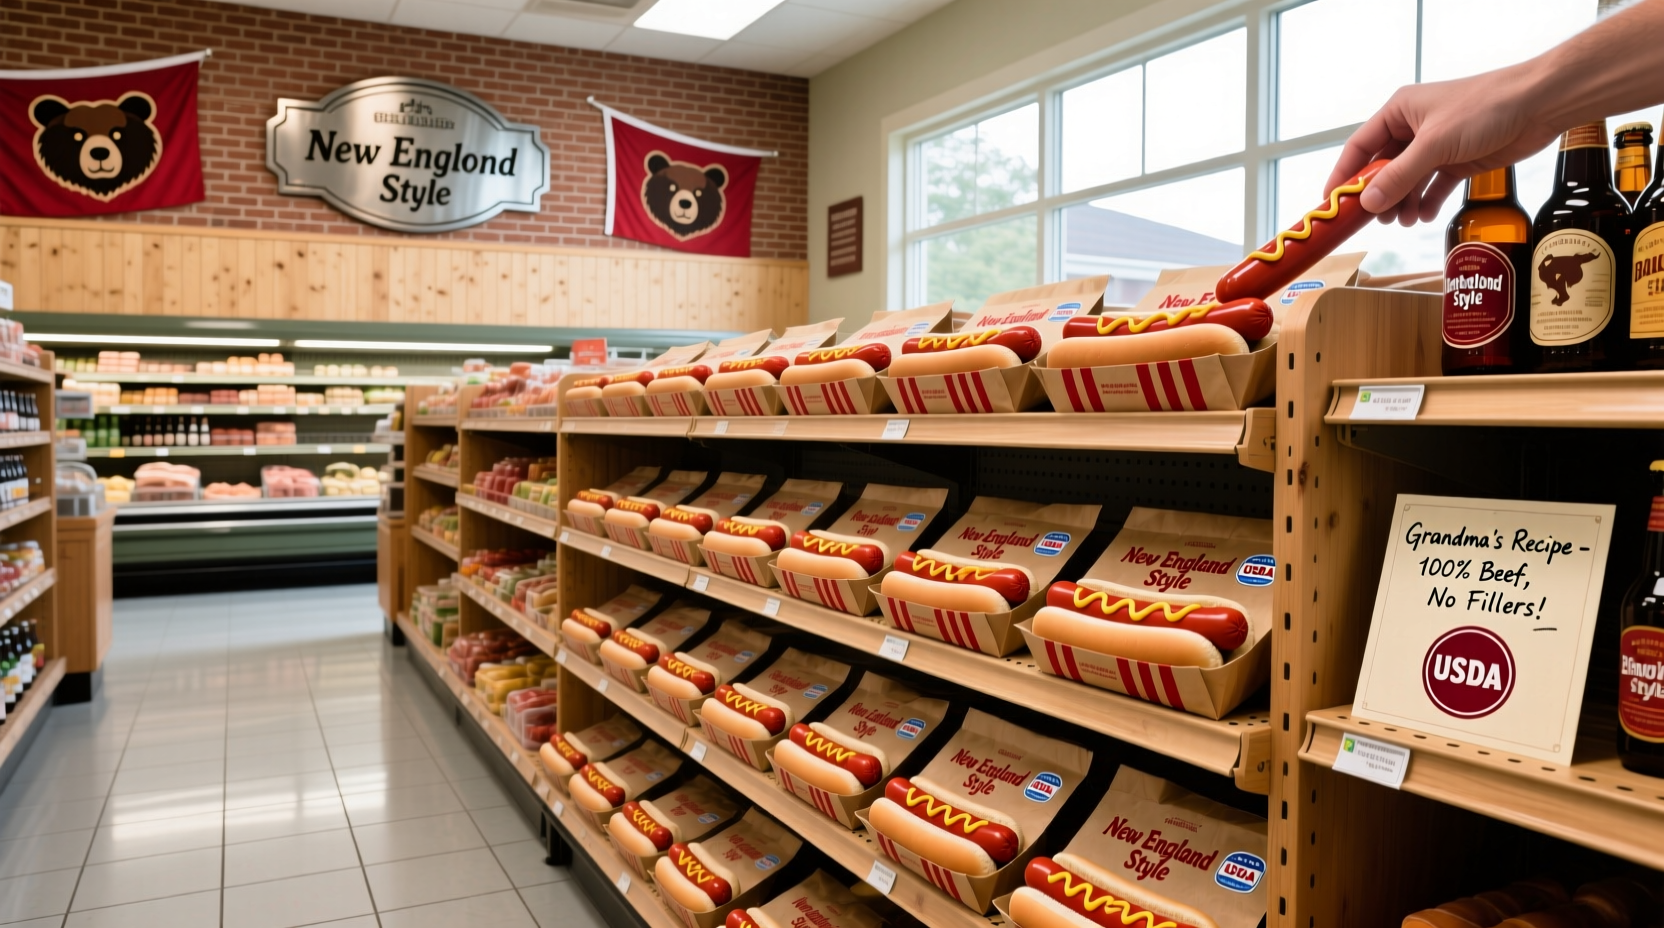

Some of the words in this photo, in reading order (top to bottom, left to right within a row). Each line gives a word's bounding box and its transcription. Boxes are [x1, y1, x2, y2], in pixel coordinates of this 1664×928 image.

[305, 129, 381, 165] New
[379, 174, 452, 212] Style
[1405, 522, 1503, 551] Grandma's
[1511, 529, 1573, 565] Recipe
[1160, 551, 1238, 575] England
[1419, 557, 1472, 580] 100%
[1479, 561, 1530, 590] Beef,
[1144, 569, 1192, 593] Style
[1427, 587, 1456, 608] No
[1466, 590, 1547, 620] Fillers!
[1433, 653, 1502, 691] USDA
[1102, 816, 1144, 845] New
[1141, 830, 1219, 871] England
[1124, 849, 1170, 881] Style
